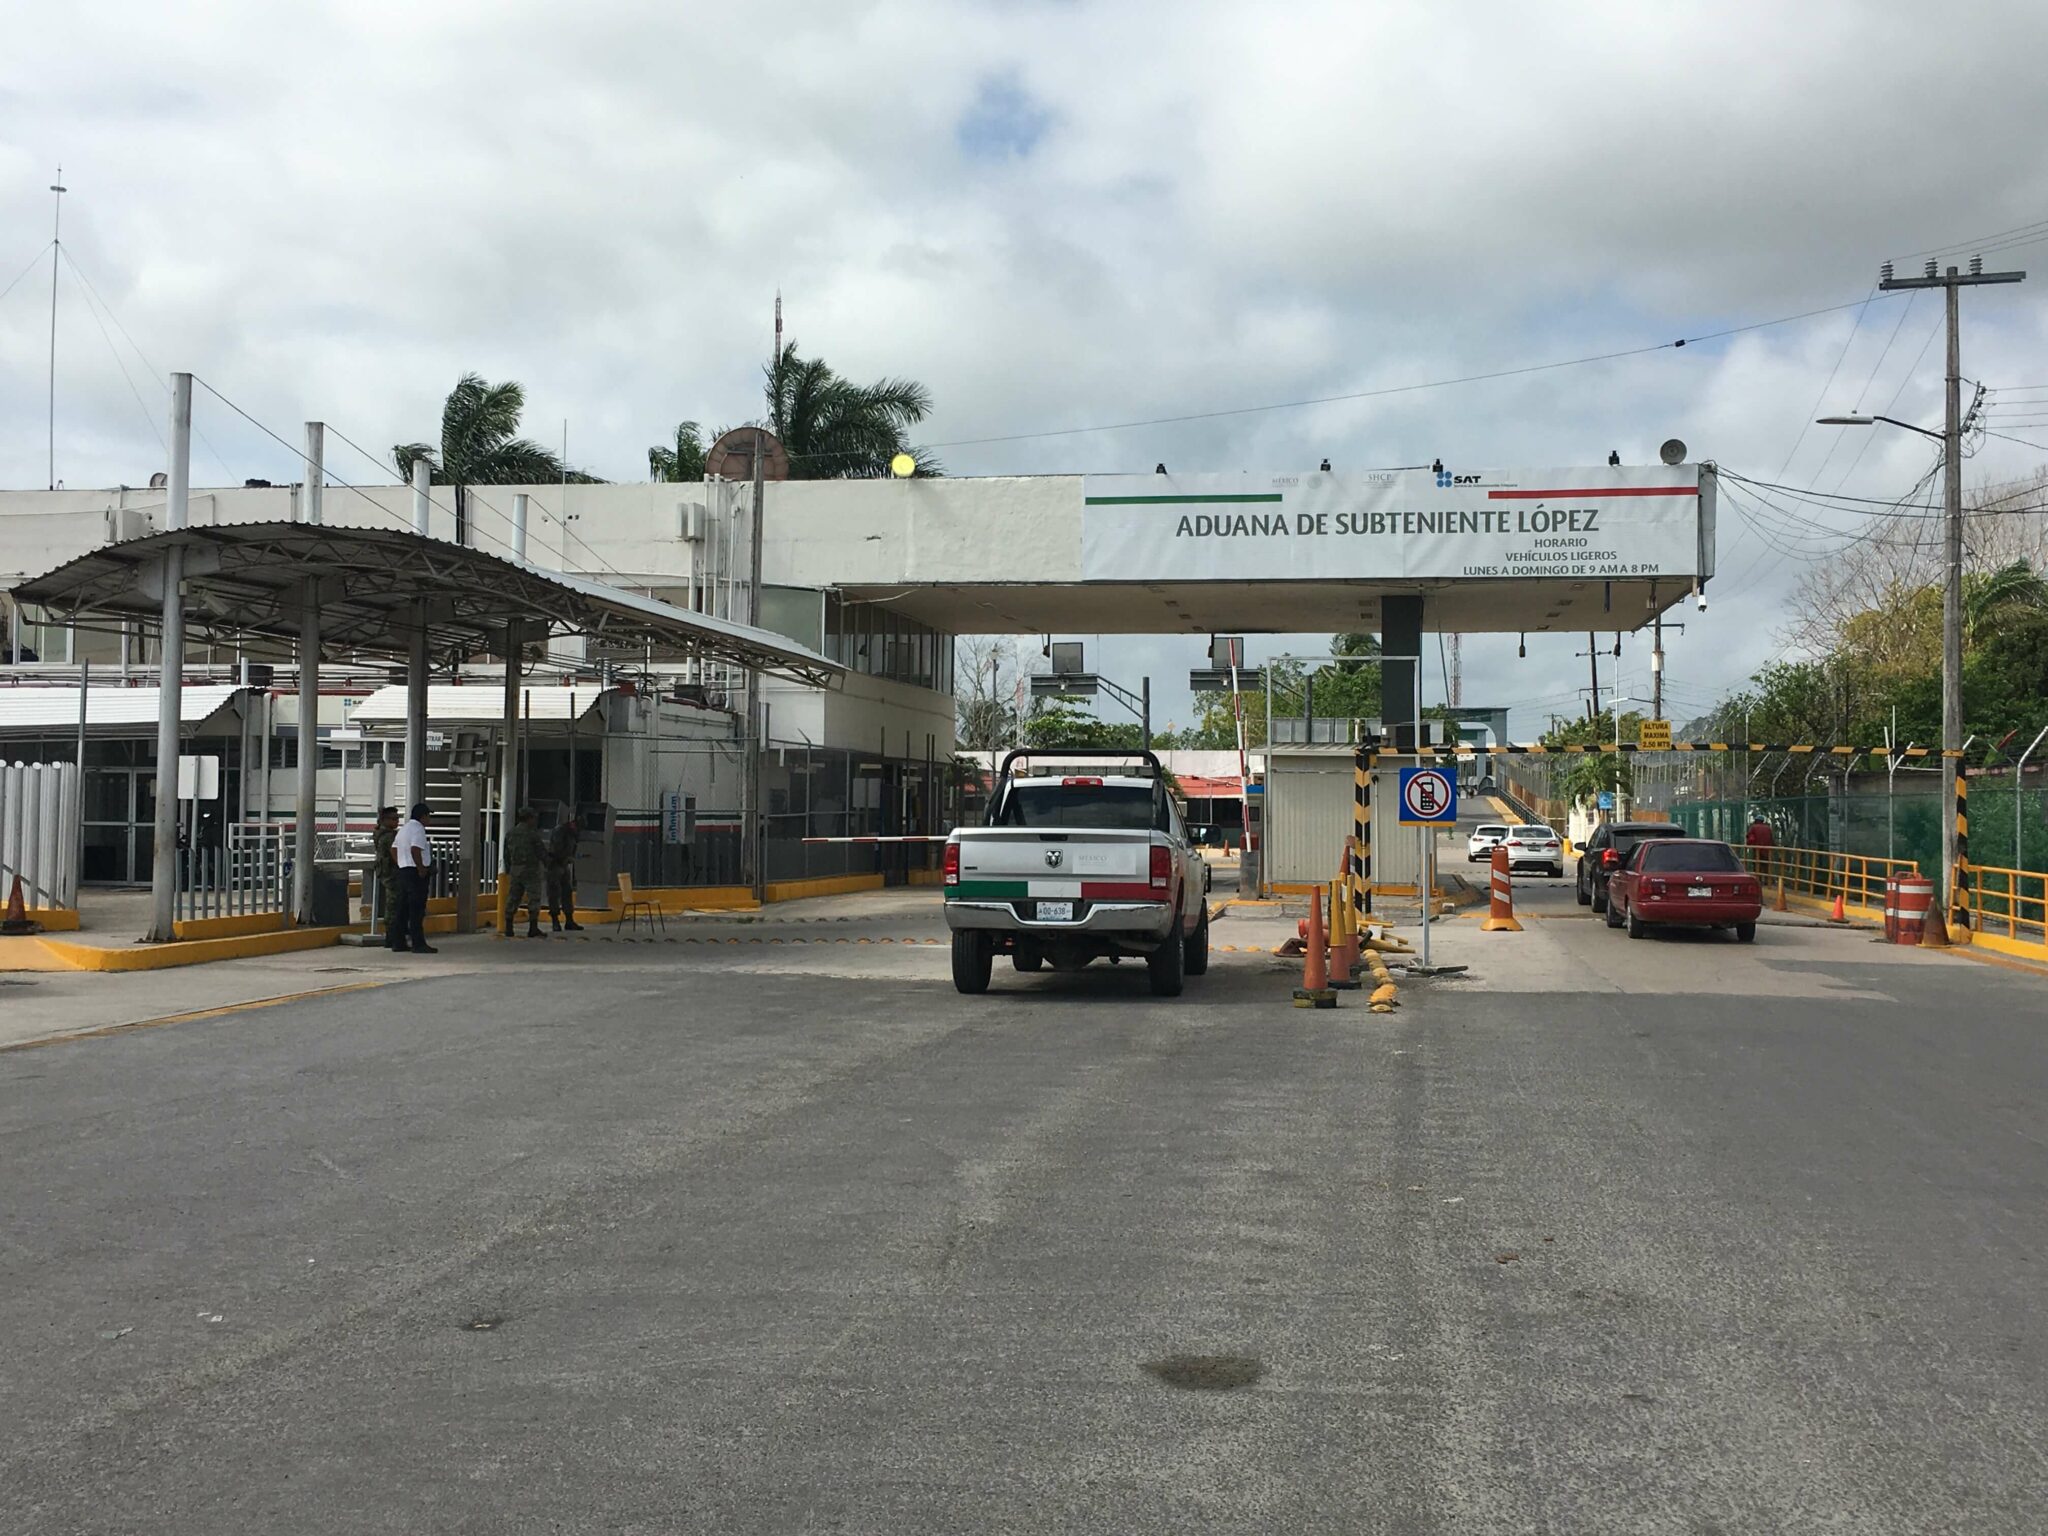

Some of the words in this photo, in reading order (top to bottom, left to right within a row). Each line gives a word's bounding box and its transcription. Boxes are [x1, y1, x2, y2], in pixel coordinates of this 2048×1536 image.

[1367, 473, 1392, 481] SHCP
[1453, 475, 1481, 484] SAT
[1176, 514, 1289, 537] ADUANA
[1297, 513, 1329, 536] DE
[1335, 511, 1511, 535] SUBTENIENTE
[1518, 503, 1600, 533] LÓPEZ
[1534, 538, 1588, 548] HORARIO
[1505, 550, 1568, 562] VEHÍCULOS
[1570, 551, 1617, 561] LIGEROS
[1463, 566, 1498, 576] LUNES
[1501, 566, 1510, 576] A
[1512, 565, 1569, 575] DOMINGO
[1571, 565, 1586, 574] DE
[1588, 565, 1596, 574] 9
[1631, 564, 1638, 573] 8
[1641, 564, 1659, 573] PM
